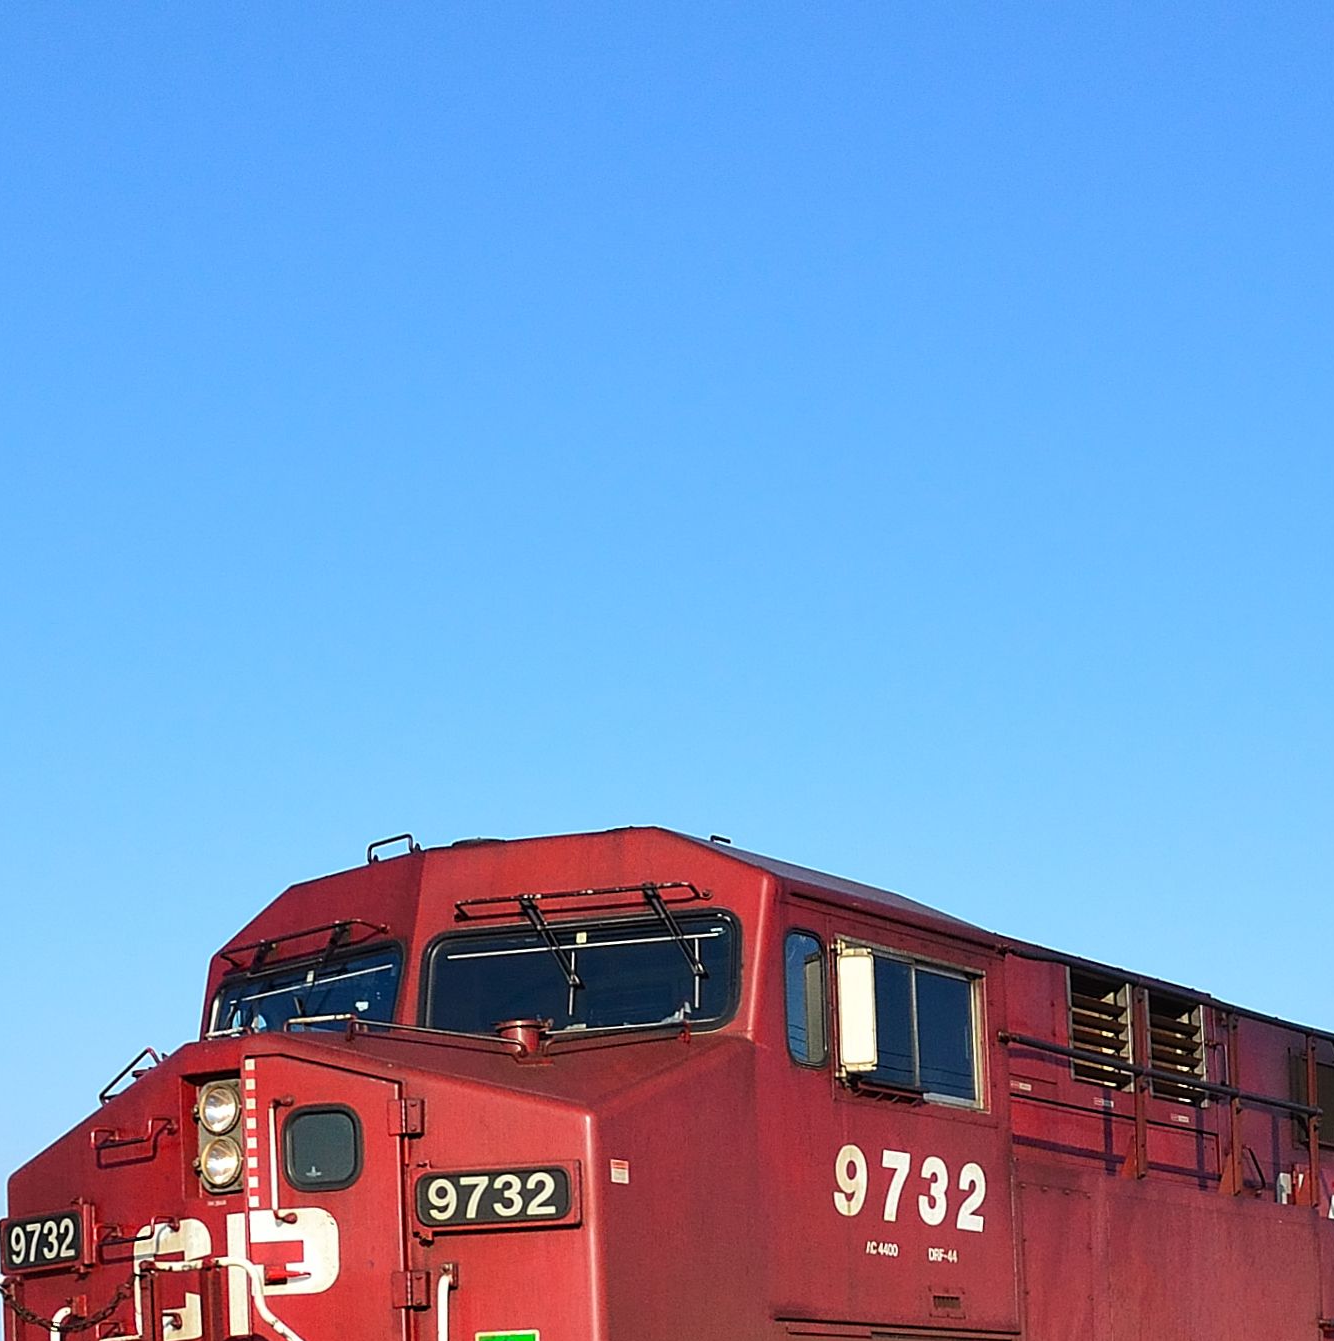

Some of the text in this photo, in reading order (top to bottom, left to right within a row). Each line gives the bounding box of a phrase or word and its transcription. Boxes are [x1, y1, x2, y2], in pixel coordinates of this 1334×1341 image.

[427, 1171, 556, 1221] 9732
[833, 1143, 987, 1233] 9732
[9, 1217, 76, 1264] 9732
